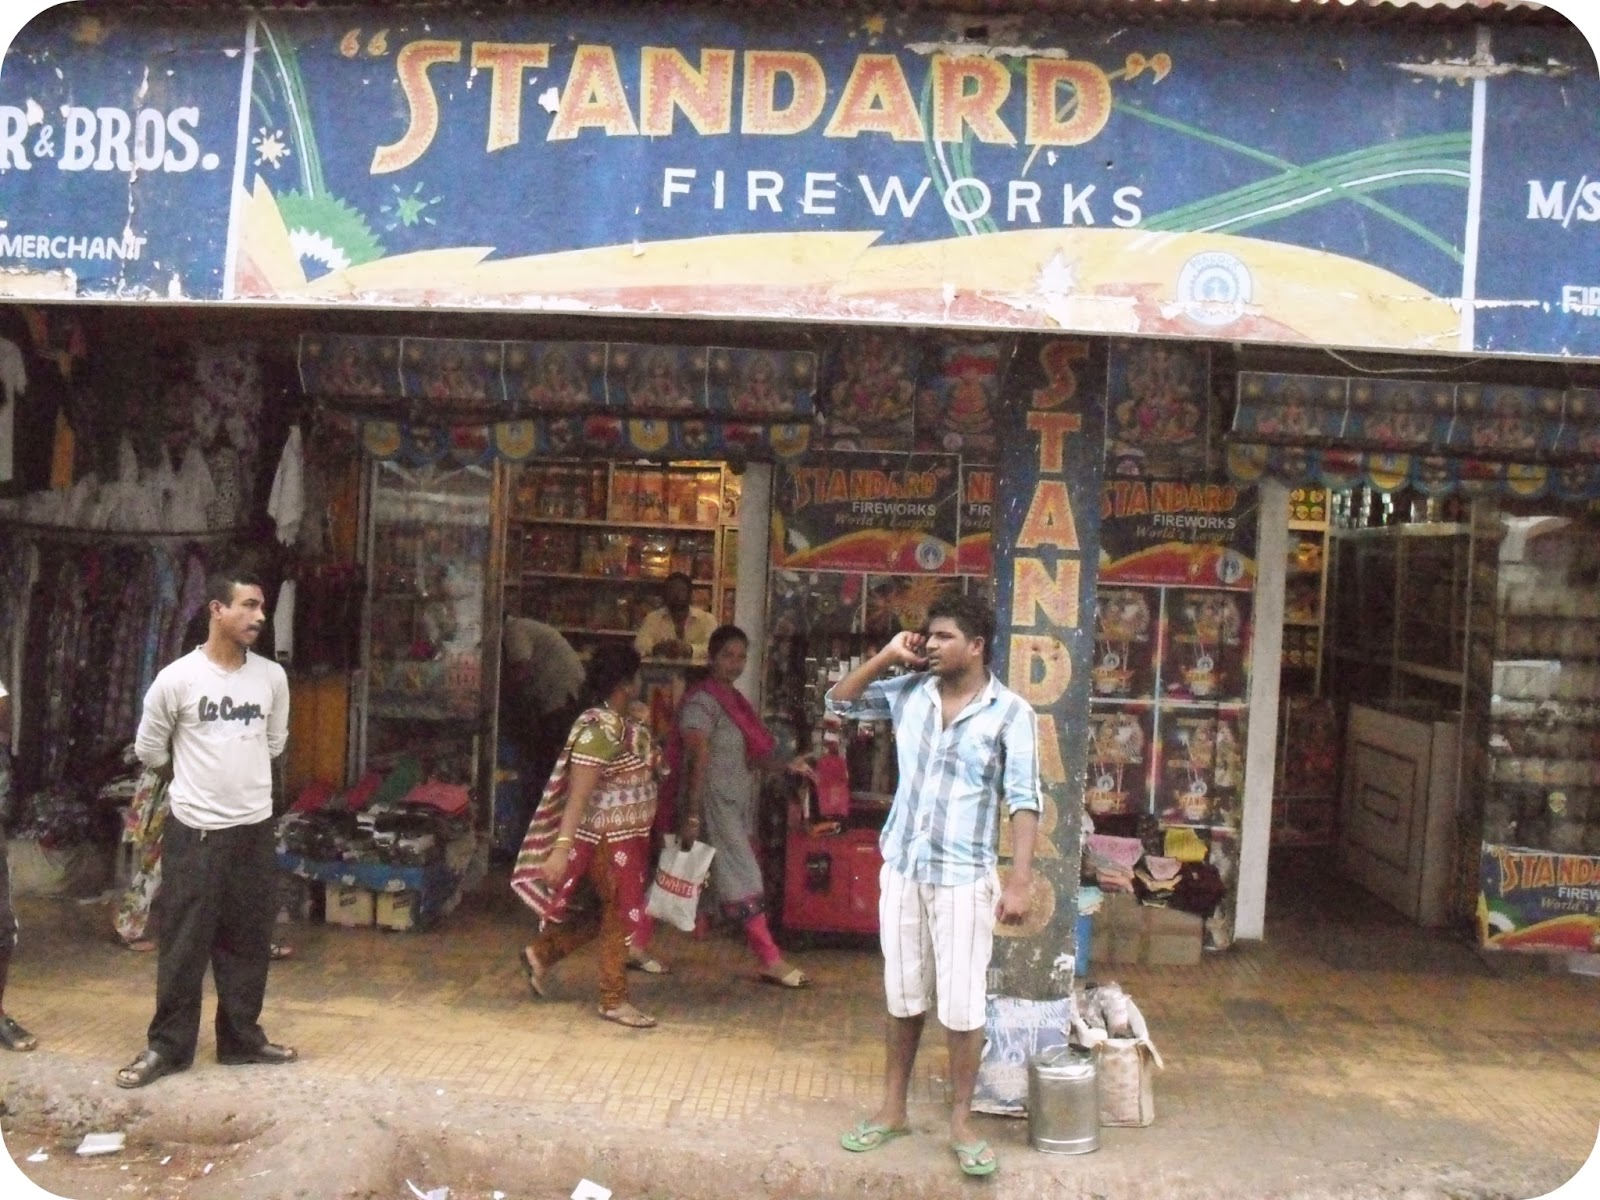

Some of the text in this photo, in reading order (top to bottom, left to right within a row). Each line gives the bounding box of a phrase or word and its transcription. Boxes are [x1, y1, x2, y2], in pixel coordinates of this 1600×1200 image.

[34, 125, 55, 157] &
[58, 106, 220, 172] BROS.
[662, 167, 1144, 228] FIREWORKS
[0, 234, 147, 260] MERCHANT
[852, 501, 937, 517] FIREWORKS
[1153, 514, 1237, 530] FIREWORKS
